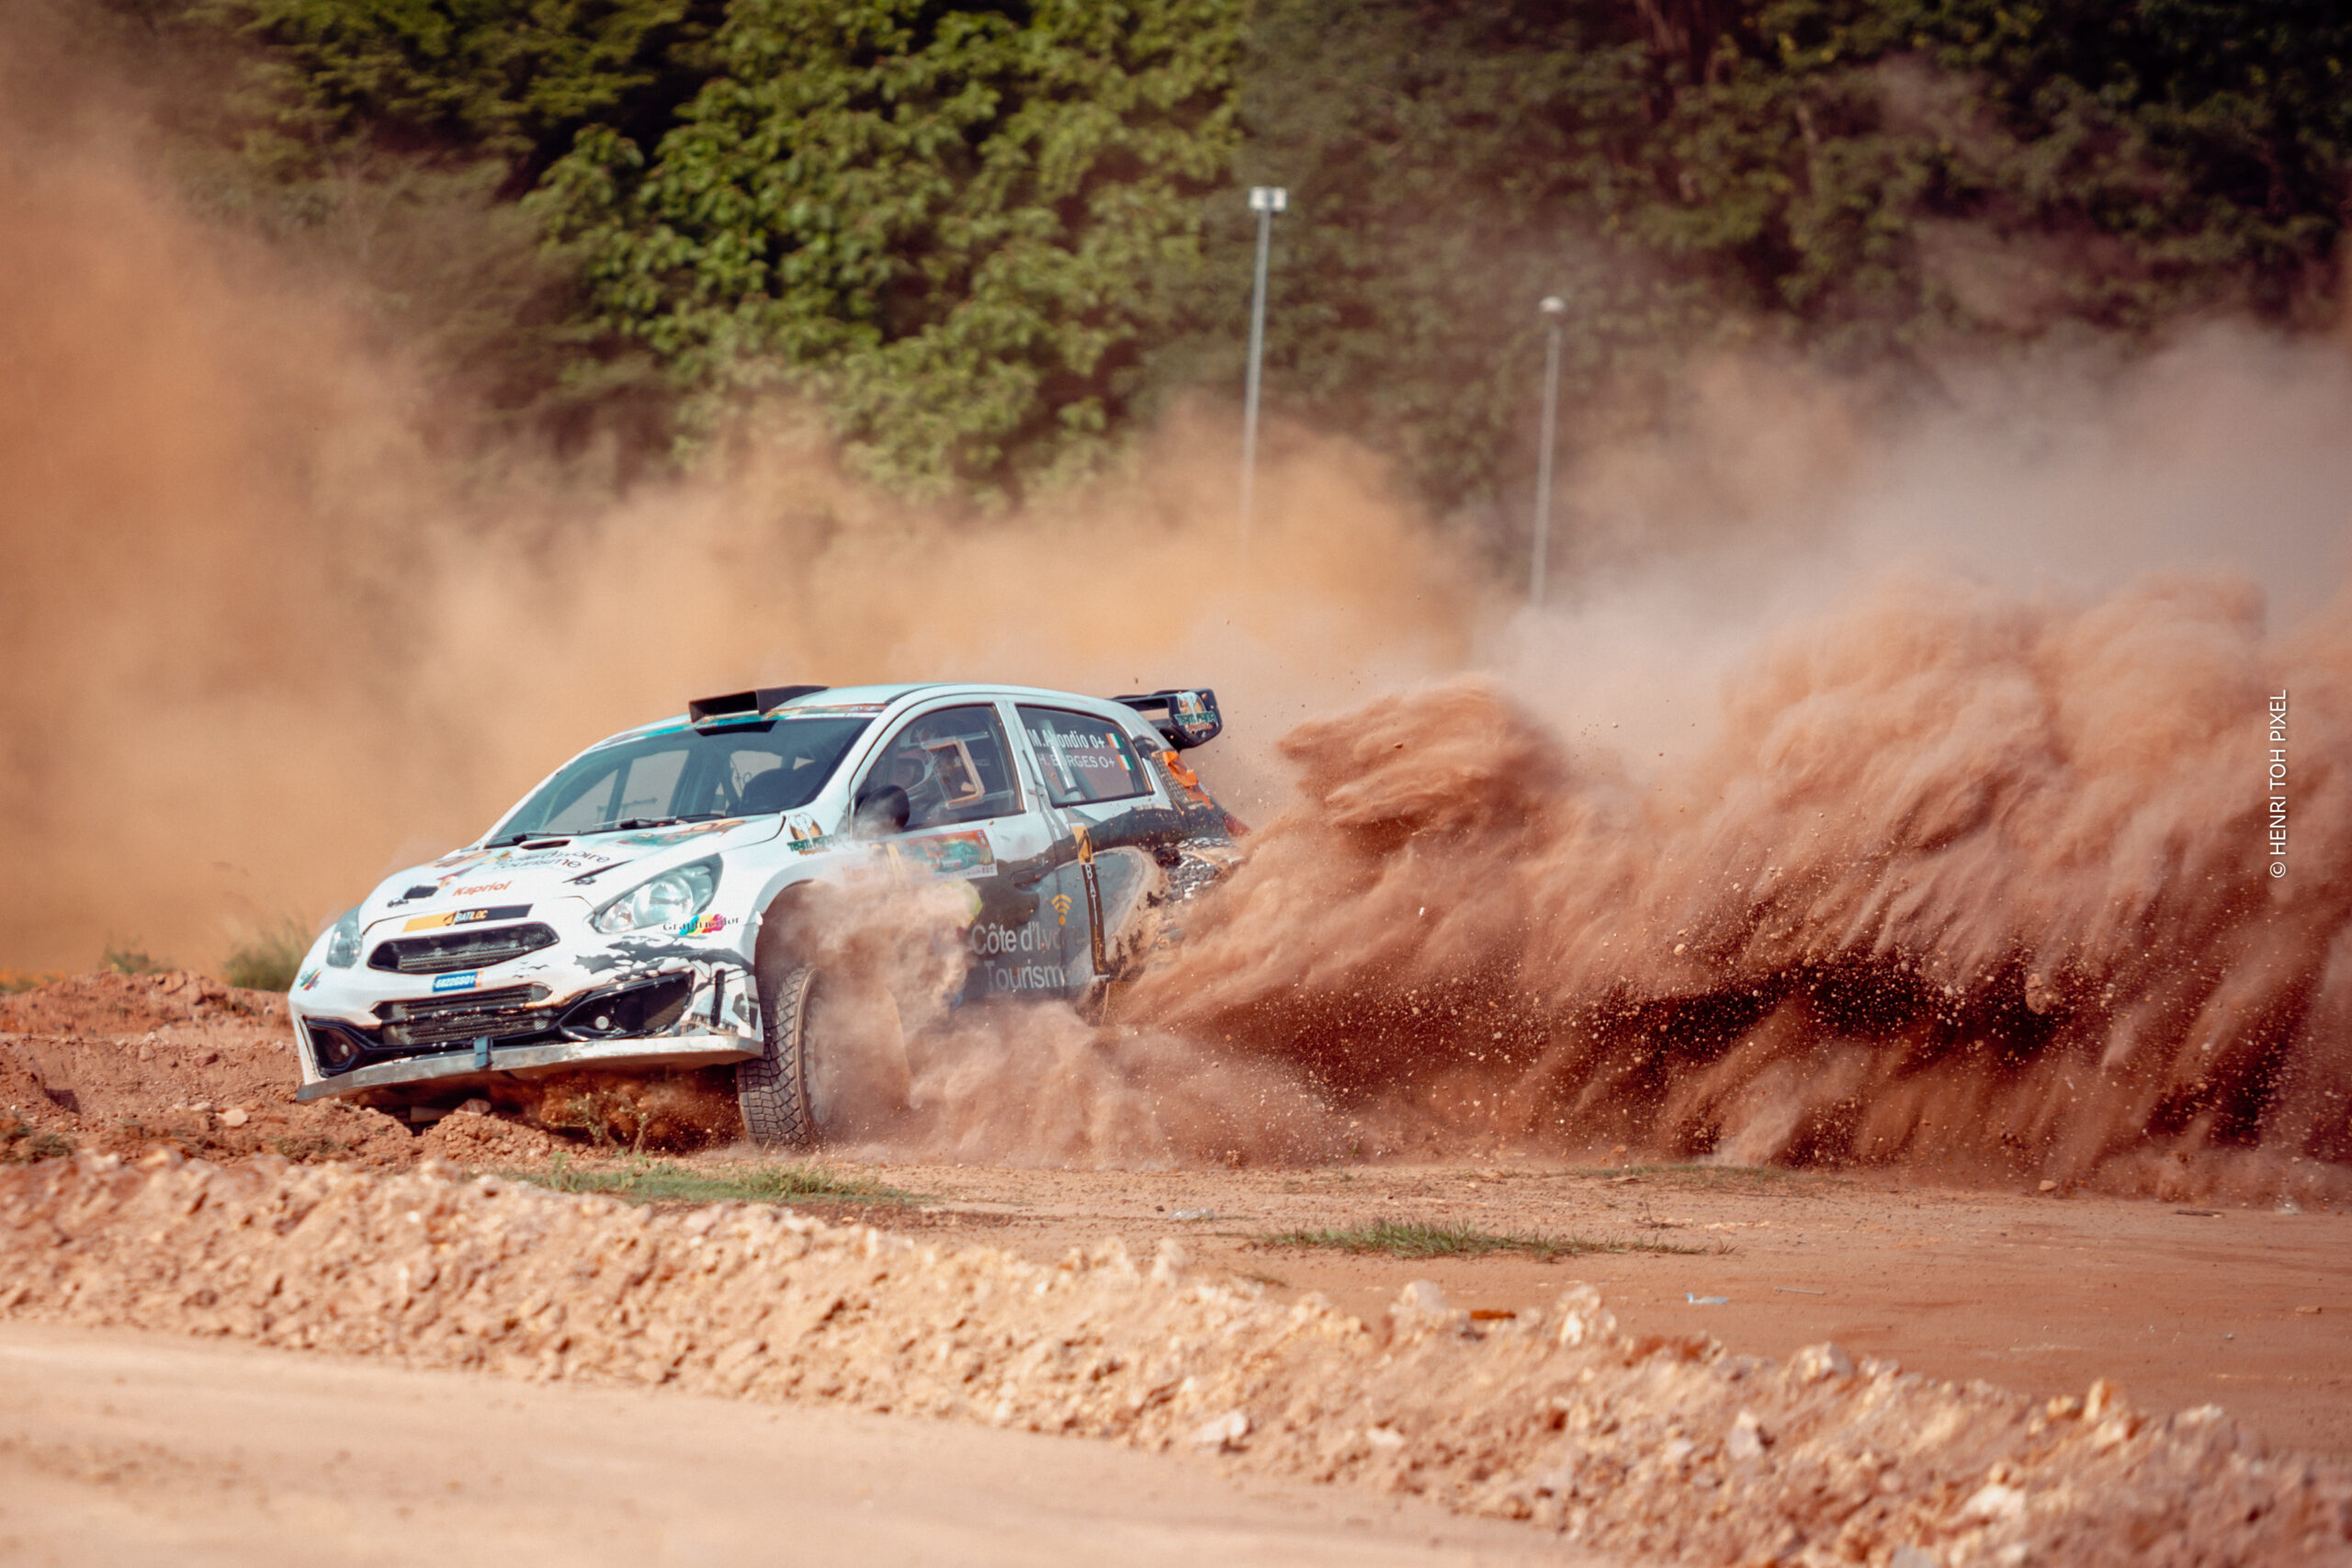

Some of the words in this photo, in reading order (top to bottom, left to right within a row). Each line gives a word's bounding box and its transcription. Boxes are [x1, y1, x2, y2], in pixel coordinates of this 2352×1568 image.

[1027, 728, 1090, 749] M.Aondio
[1050, 754, 1098, 768] BRGES
[452, 880, 513, 897] Kapriol
[971, 921, 1017, 955] Côte
